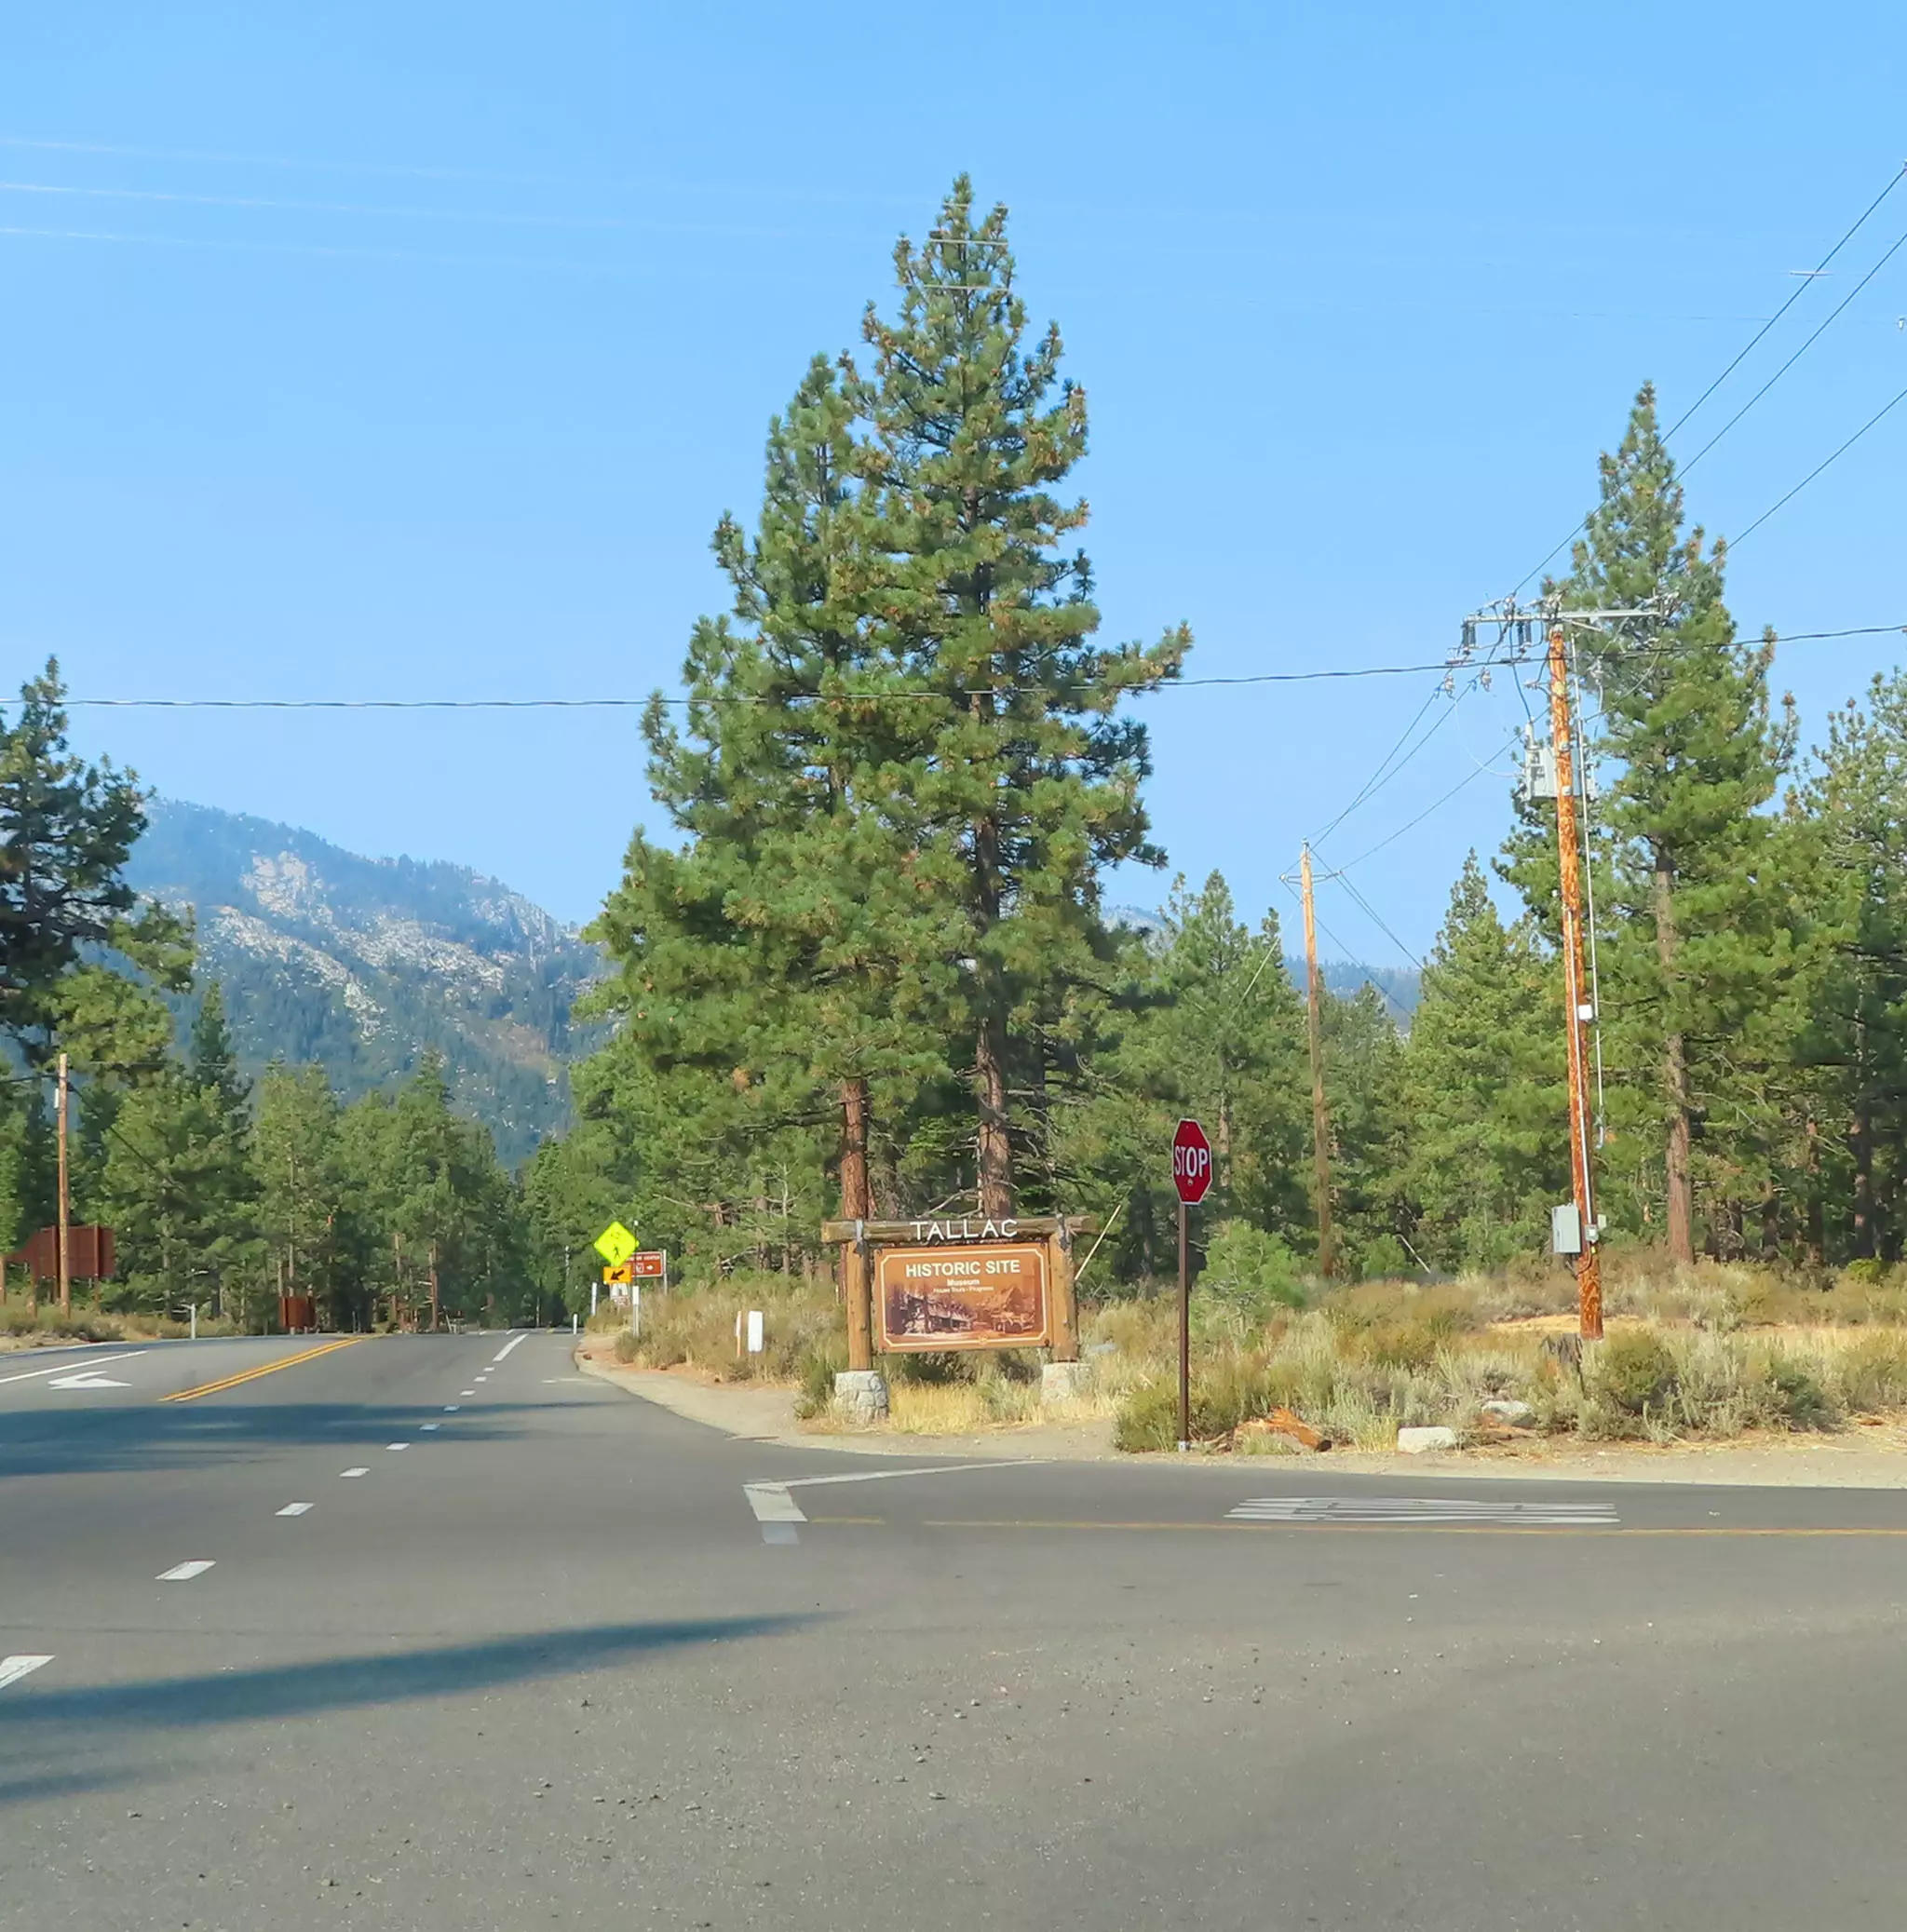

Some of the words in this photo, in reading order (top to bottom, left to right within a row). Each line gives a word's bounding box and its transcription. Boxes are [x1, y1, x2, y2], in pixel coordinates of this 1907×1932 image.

[1174, 1145, 1208, 1177] STOP
[910, 1219, 1018, 1240] TALLAC
[906, 1262, 981, 1277] HISTORIC
[985, 1260, 1021, 1274] SITE
[947, 1278, 980, 1287] Museum
